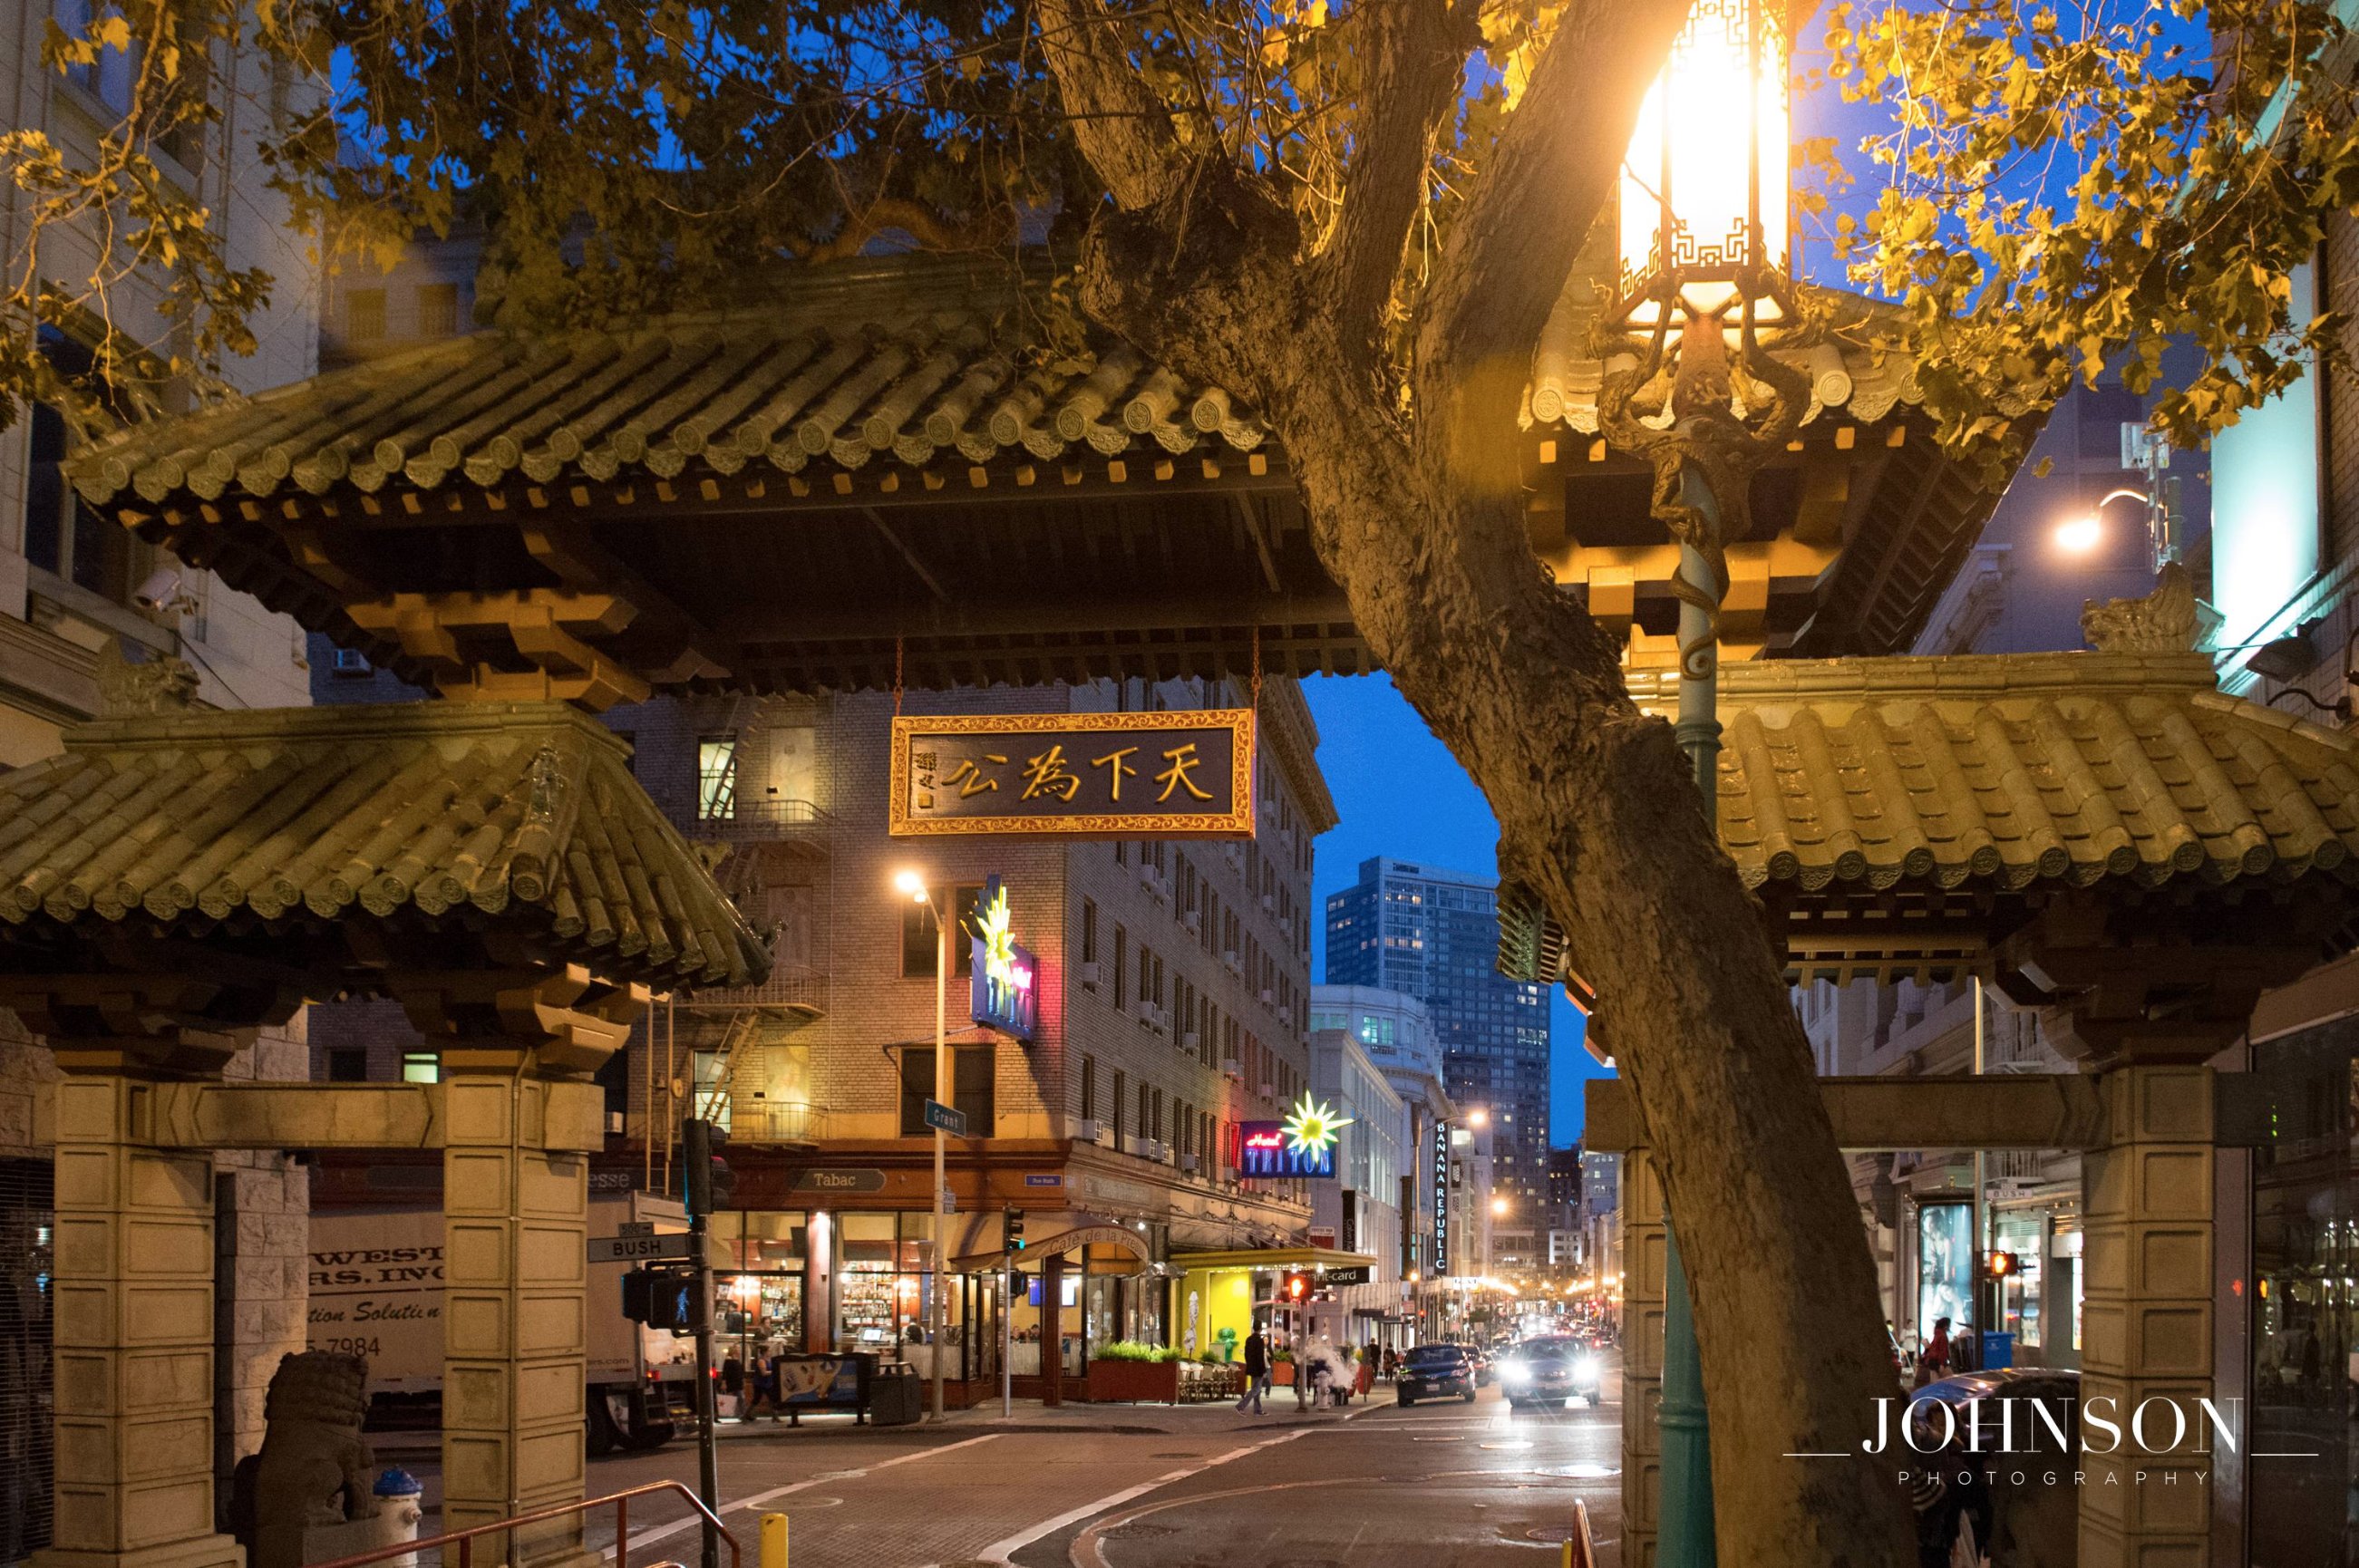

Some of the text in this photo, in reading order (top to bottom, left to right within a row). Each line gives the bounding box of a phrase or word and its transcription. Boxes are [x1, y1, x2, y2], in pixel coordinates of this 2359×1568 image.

[934, 1108, 958, 1129] Grant
[1247, 1133, 1283, 1146] Hotel
[1246, 1148, 1330, 1174] TRITON
[813, 1173, 856, 1186] Tabac
[1435, 1122, 1446, 1269] BANANA REPUBLIC
[613, 1240, 661, 1256] BUSH
[1050, 1234, 1081, 1253] Café
[1085, 1230, 1101, 1243] de
[1107, 1229, 1117, 1242] la
